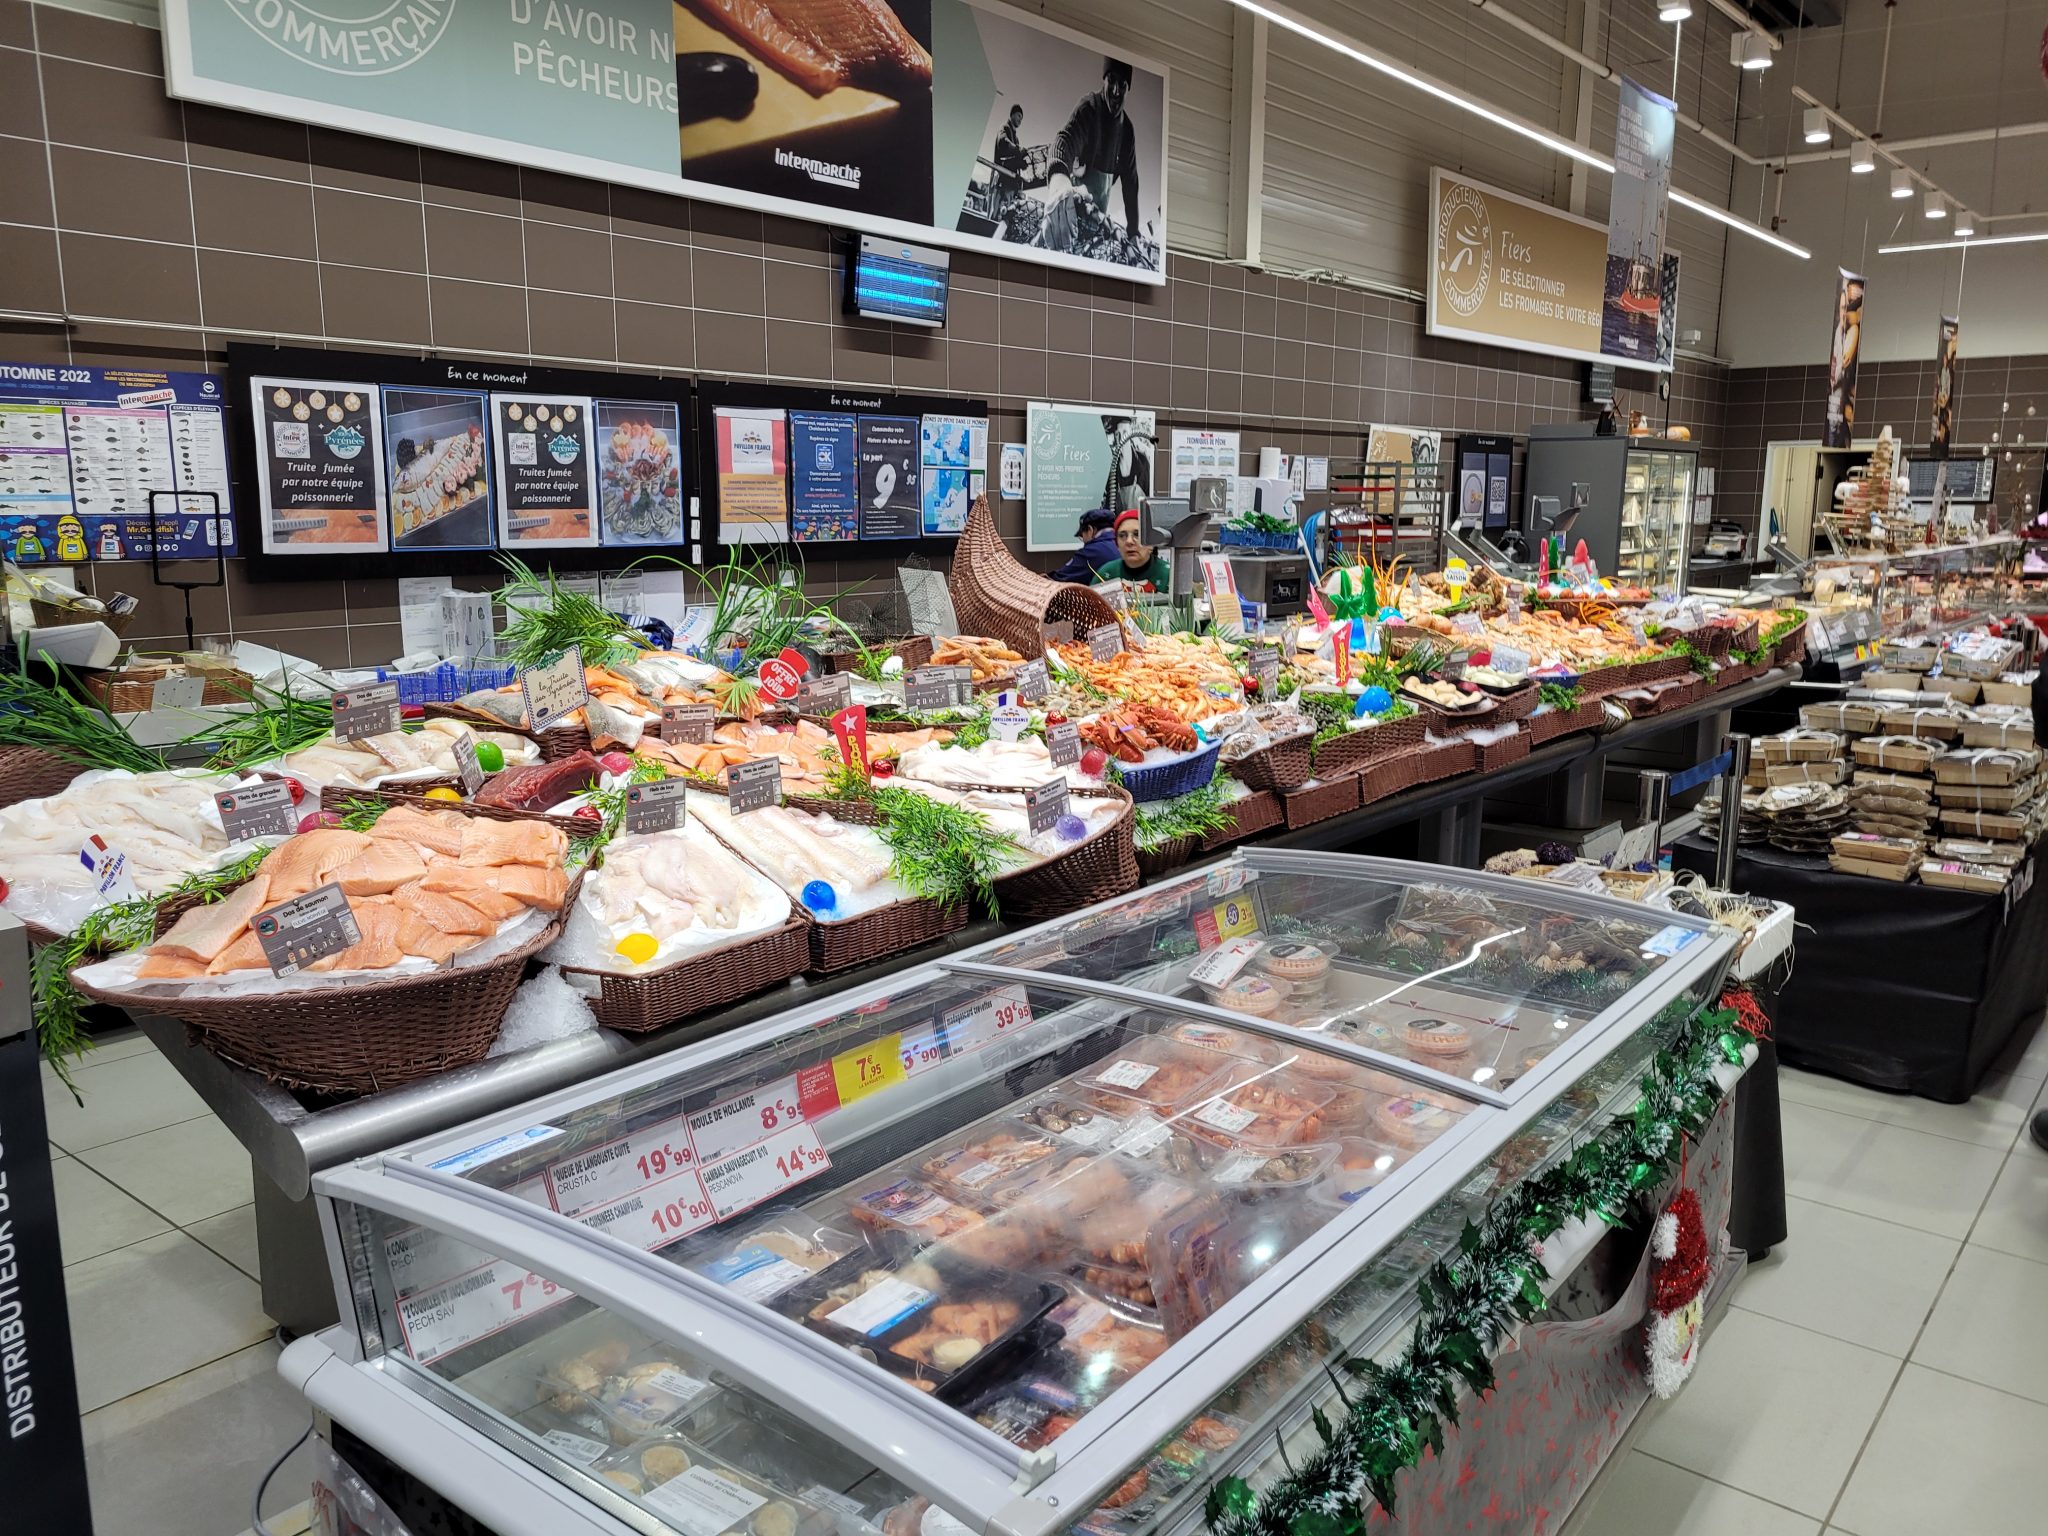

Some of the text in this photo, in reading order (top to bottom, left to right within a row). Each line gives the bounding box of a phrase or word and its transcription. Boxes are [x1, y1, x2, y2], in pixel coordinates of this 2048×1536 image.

[238, 0, 446, 66] OMMERÇAN
[513, 39, 679, 114] PÊCHEURS
[775, 147, 862, 184] Intermarché
[1439, 187, 1484, 250] PRODUCTEURS
[1501, 231, 1531, 263] Fiers
[1500, 267, 1565, 298] DE SÉLECTIONNER
[1499, 291, 1513, 309] LES
[1515, 295, 1553, 317] FROMAGES
[1555, 304, 1564, 320] DE
[1566, 306, 1586, 324] VOTRE
[60, 370, 91, 384] 2022
[447, 367, 528, 385] En ce moment
[830, 394, 882, 408] En ce moment
[324, 435, 365, 445] Pyrénées
[1064, 444, 1091, 461] Fiers
[287, 462, 355, 475] Truite fumée
[870, 453, 884, 463] part
[281, 478, 364, 490] par notre équipe
[519, 468, 572, 479] Truites fumée
[873, 463, 897, 509] 9
[291, 492, 354, 504] poissonnerie
[514, 481, 579, 492] par notre équipe
[522, 494, 572, 505] poissonnerie
[1446, 574, 1467, 582] SAISON
[763, 675, 786, 696] JOUR
[770, 662, 798, 687] OFFRE
[259, 788, 281, 798] grenadier
[99, 852, 126, 895] PAVILLON FRANCE
[282, 909, 295, 918] Dos
[305, 895, 329, 908] saumon
[995, 1001, 1030, 1029] 39€95
[690, 1095, 756, 1131] MOULE DE HOLLANDE
[575, 1161, 584, 1172] DE
[583, 1150, 615, 1171] LANGOUSTE
[614, 1141, 631, 1158] CUITE
[637, 1143, 692, 1181] 19€99
[702, 1164, 725, 1184] GAMBAS
[725, 1149, 758, 1174] SAUVAGECUIT
[776, 1145, 825, 1178] 14€99
[557, 1170, 598, 1195] CRUSTA C
[708, 1173, 744, 1195] PESCANOVA
[613, 1197, 644, 1219] CHAMPAGNE
[652, 1197, 709, 1234] 10€90
[408, 1304, 455, 1334] PECH SAV
